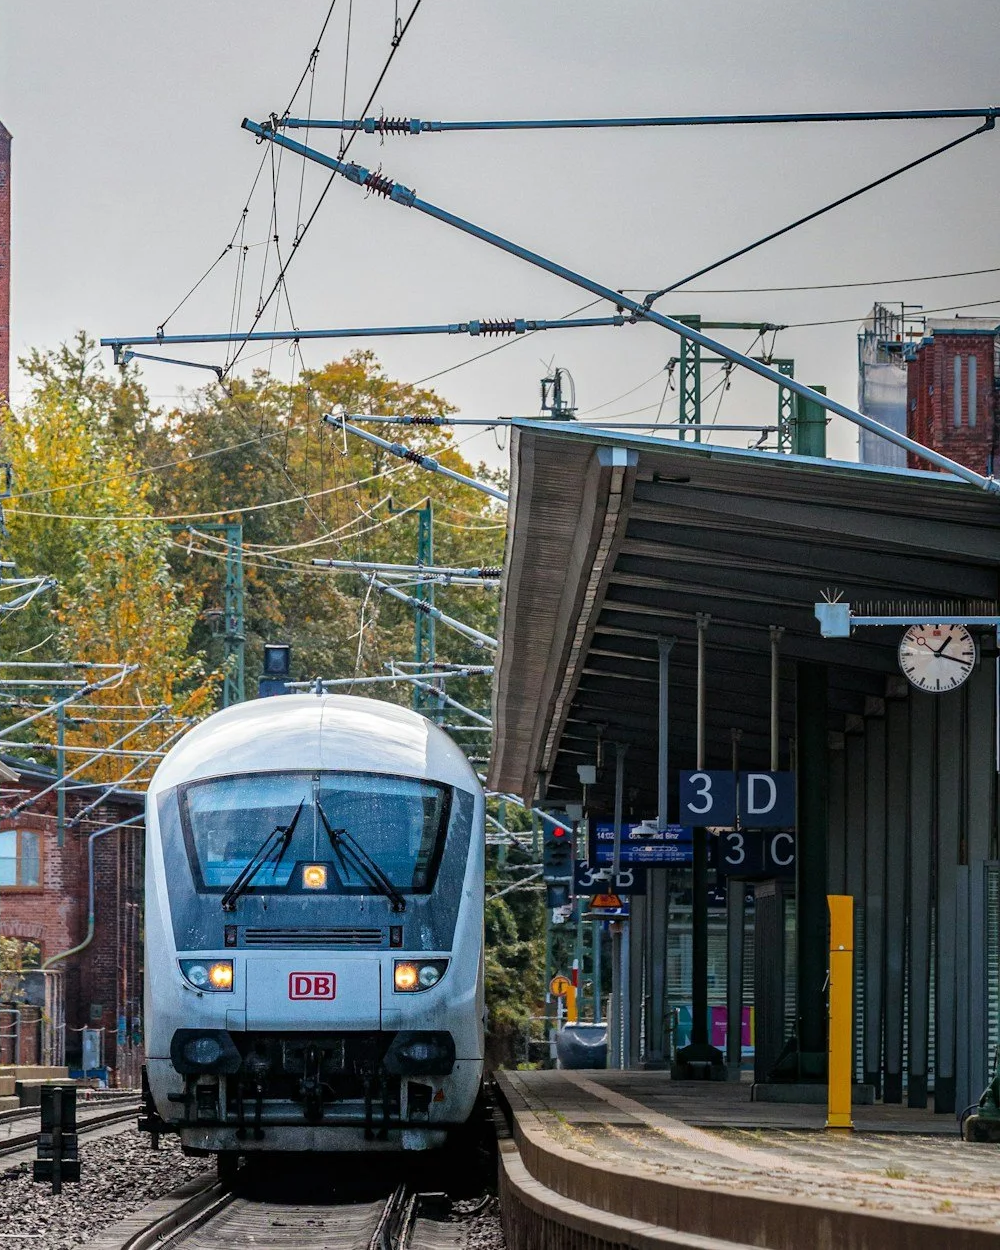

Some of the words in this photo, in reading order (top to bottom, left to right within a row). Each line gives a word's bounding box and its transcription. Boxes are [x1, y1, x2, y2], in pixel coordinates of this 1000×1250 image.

[687, 773, 714, 814] 3
[746, 774, 777, 814] D
[725, 833, 746, 866] 3
[771, 833, 794, 866] C
[295, 976, 330, 996] DB
